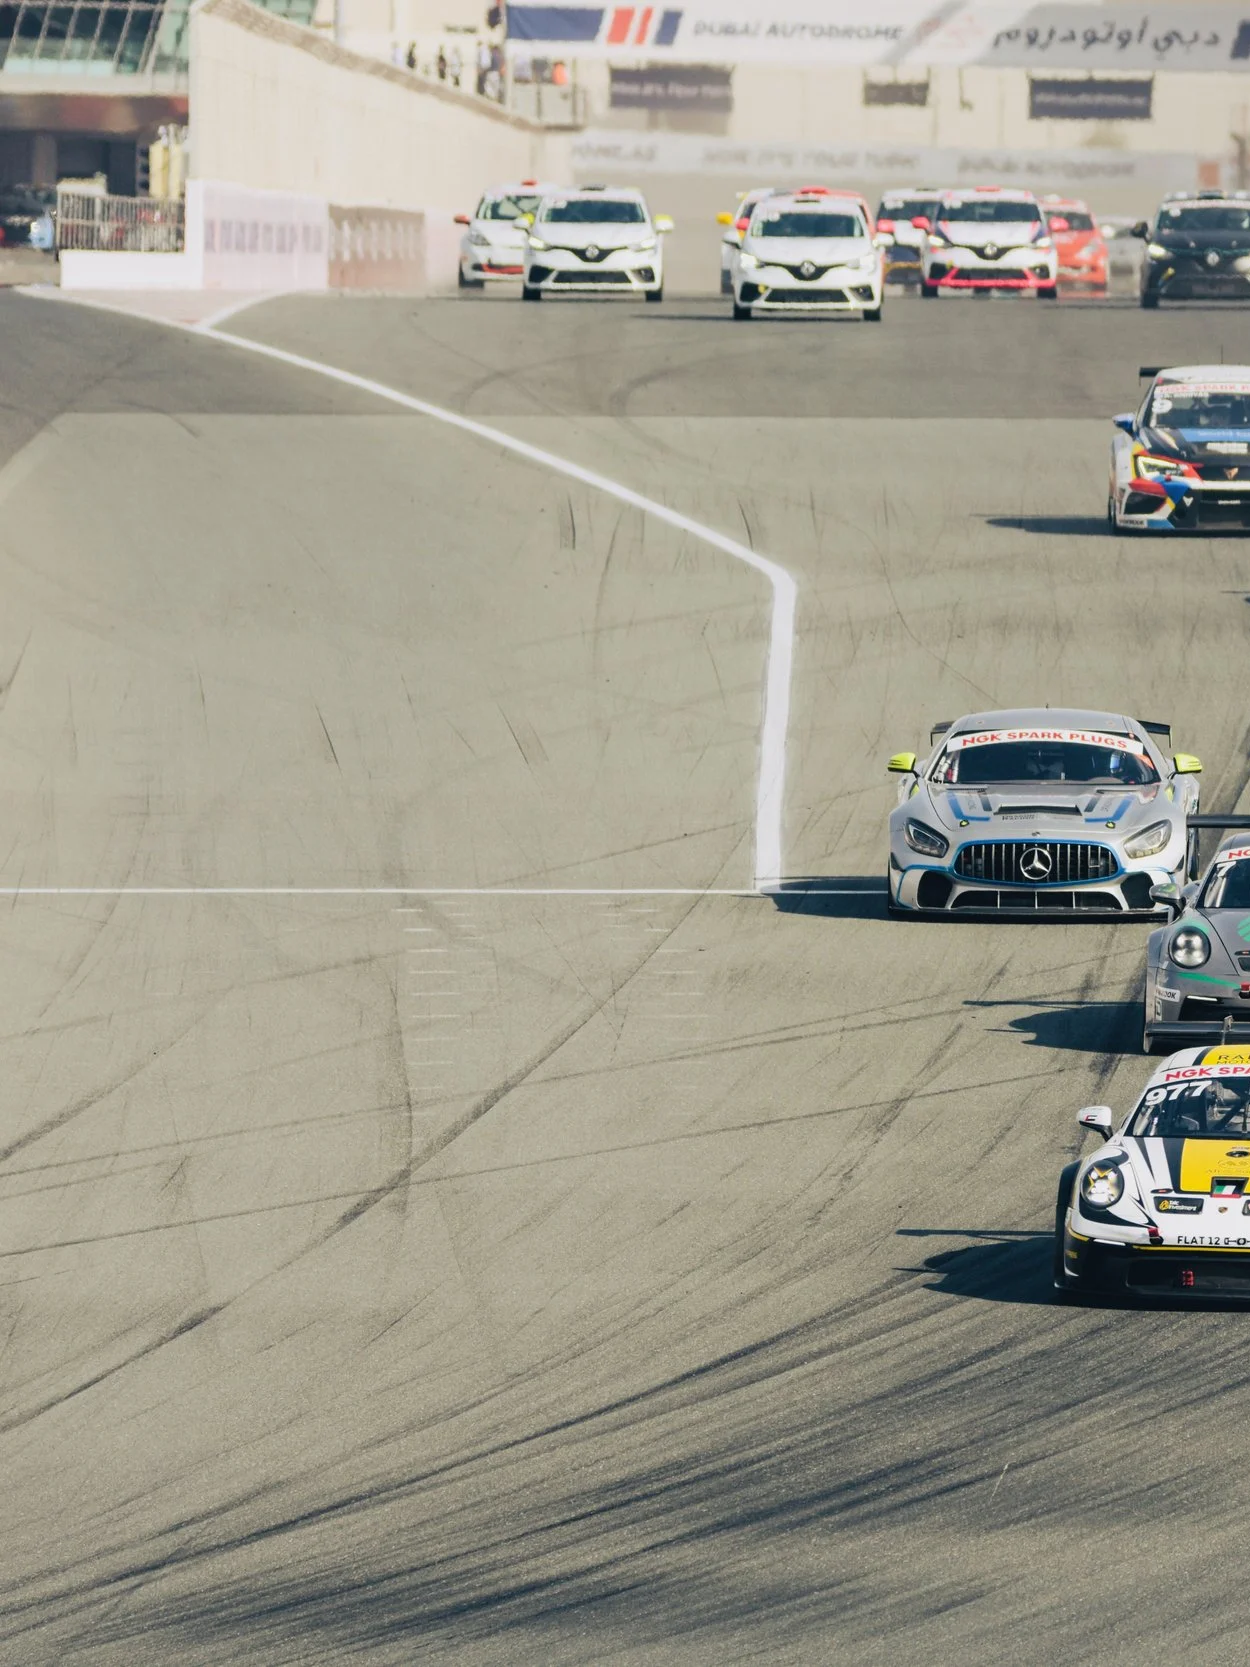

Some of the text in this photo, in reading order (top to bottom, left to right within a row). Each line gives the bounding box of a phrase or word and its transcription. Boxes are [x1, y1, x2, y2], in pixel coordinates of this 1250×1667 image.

[693, 19, 905, 40] DUBAI AUTODROME
[962, 731, 1127, 749] NGK SPARK PLUGS
[1165, 1068, 1214, 1082] NGK
[1145, 1080, 1213, 1106] 977
[1177, 1235, 1220, 1245] FLAT 12
